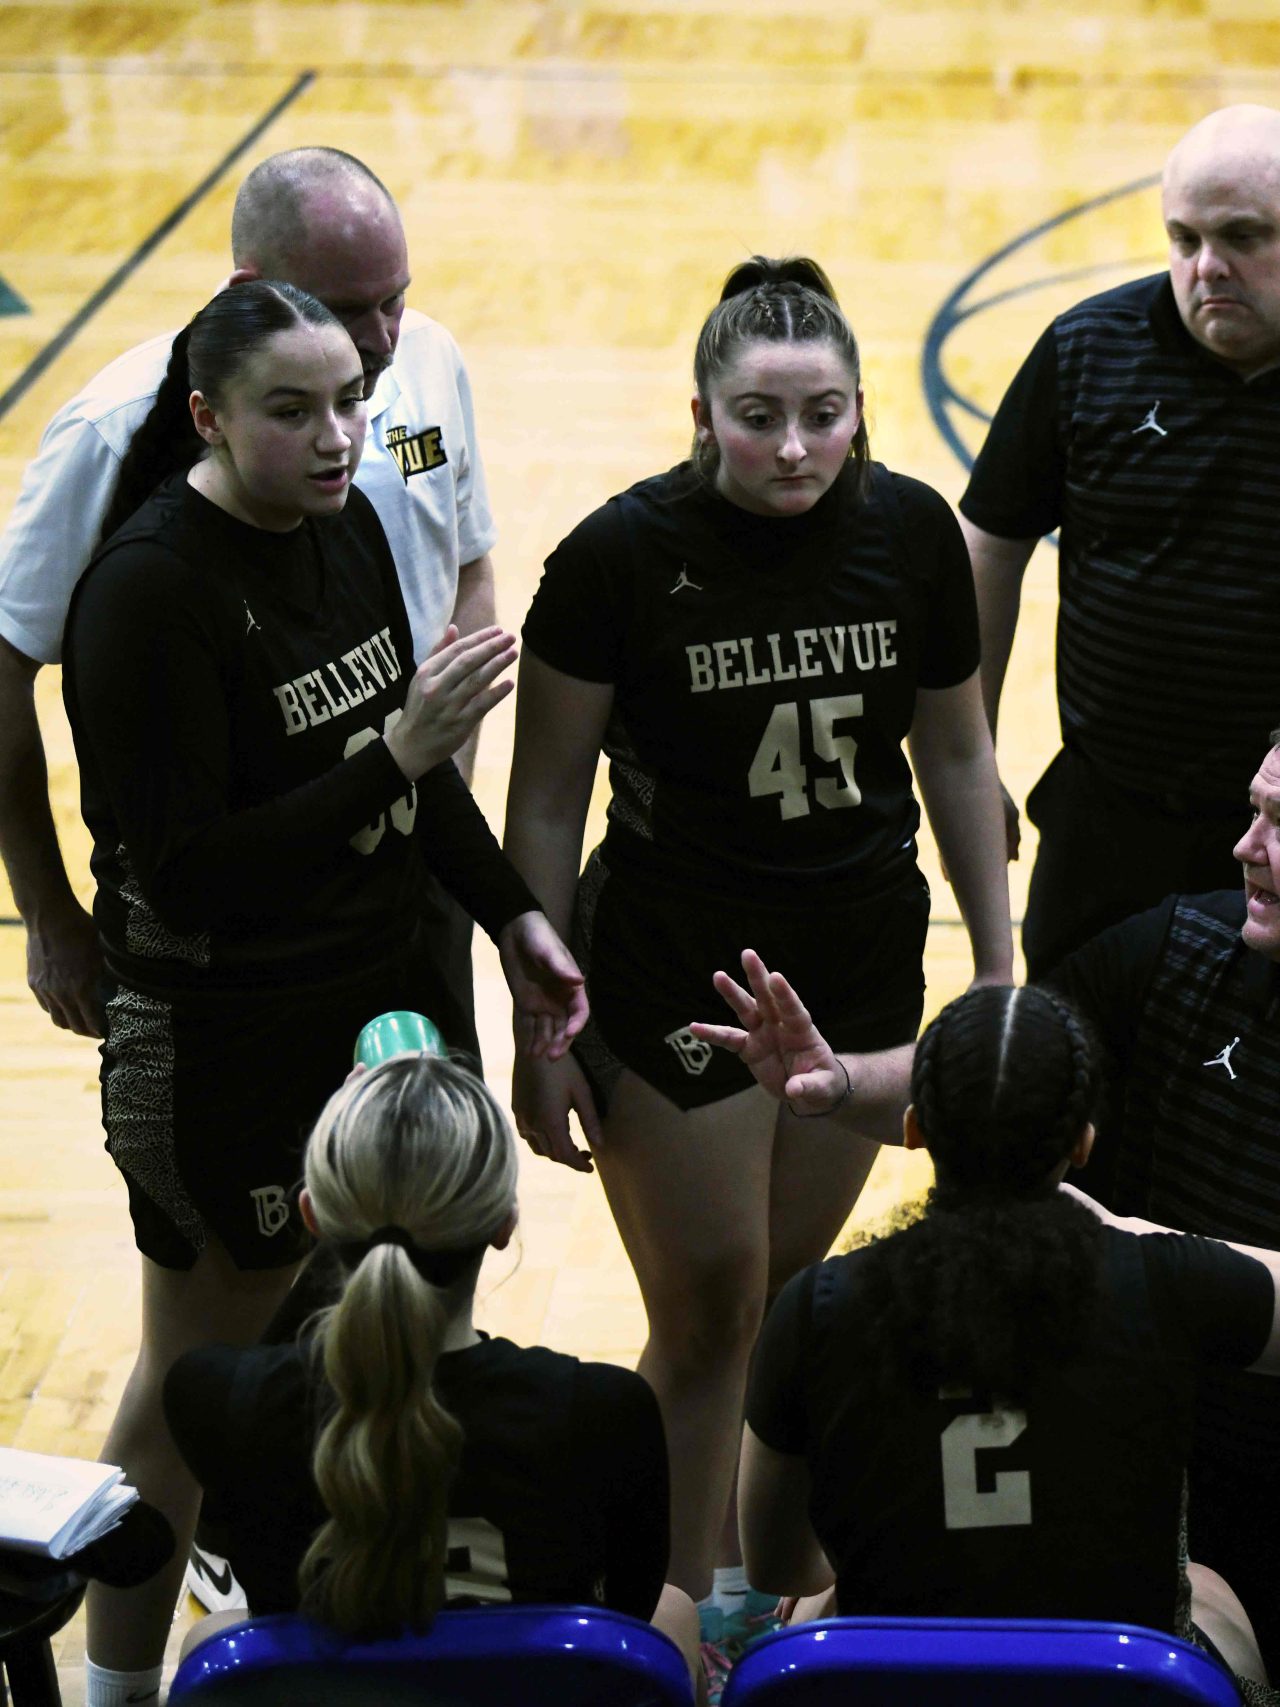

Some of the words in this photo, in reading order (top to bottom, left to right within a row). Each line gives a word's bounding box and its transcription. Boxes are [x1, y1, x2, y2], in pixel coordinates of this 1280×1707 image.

[386, 427, 448, 486] VUE
[273, 626, 402, 736] BELLEVU
[685, 620, 898, 693] BELLEVUE
[748, 694, 864, 821] 45
